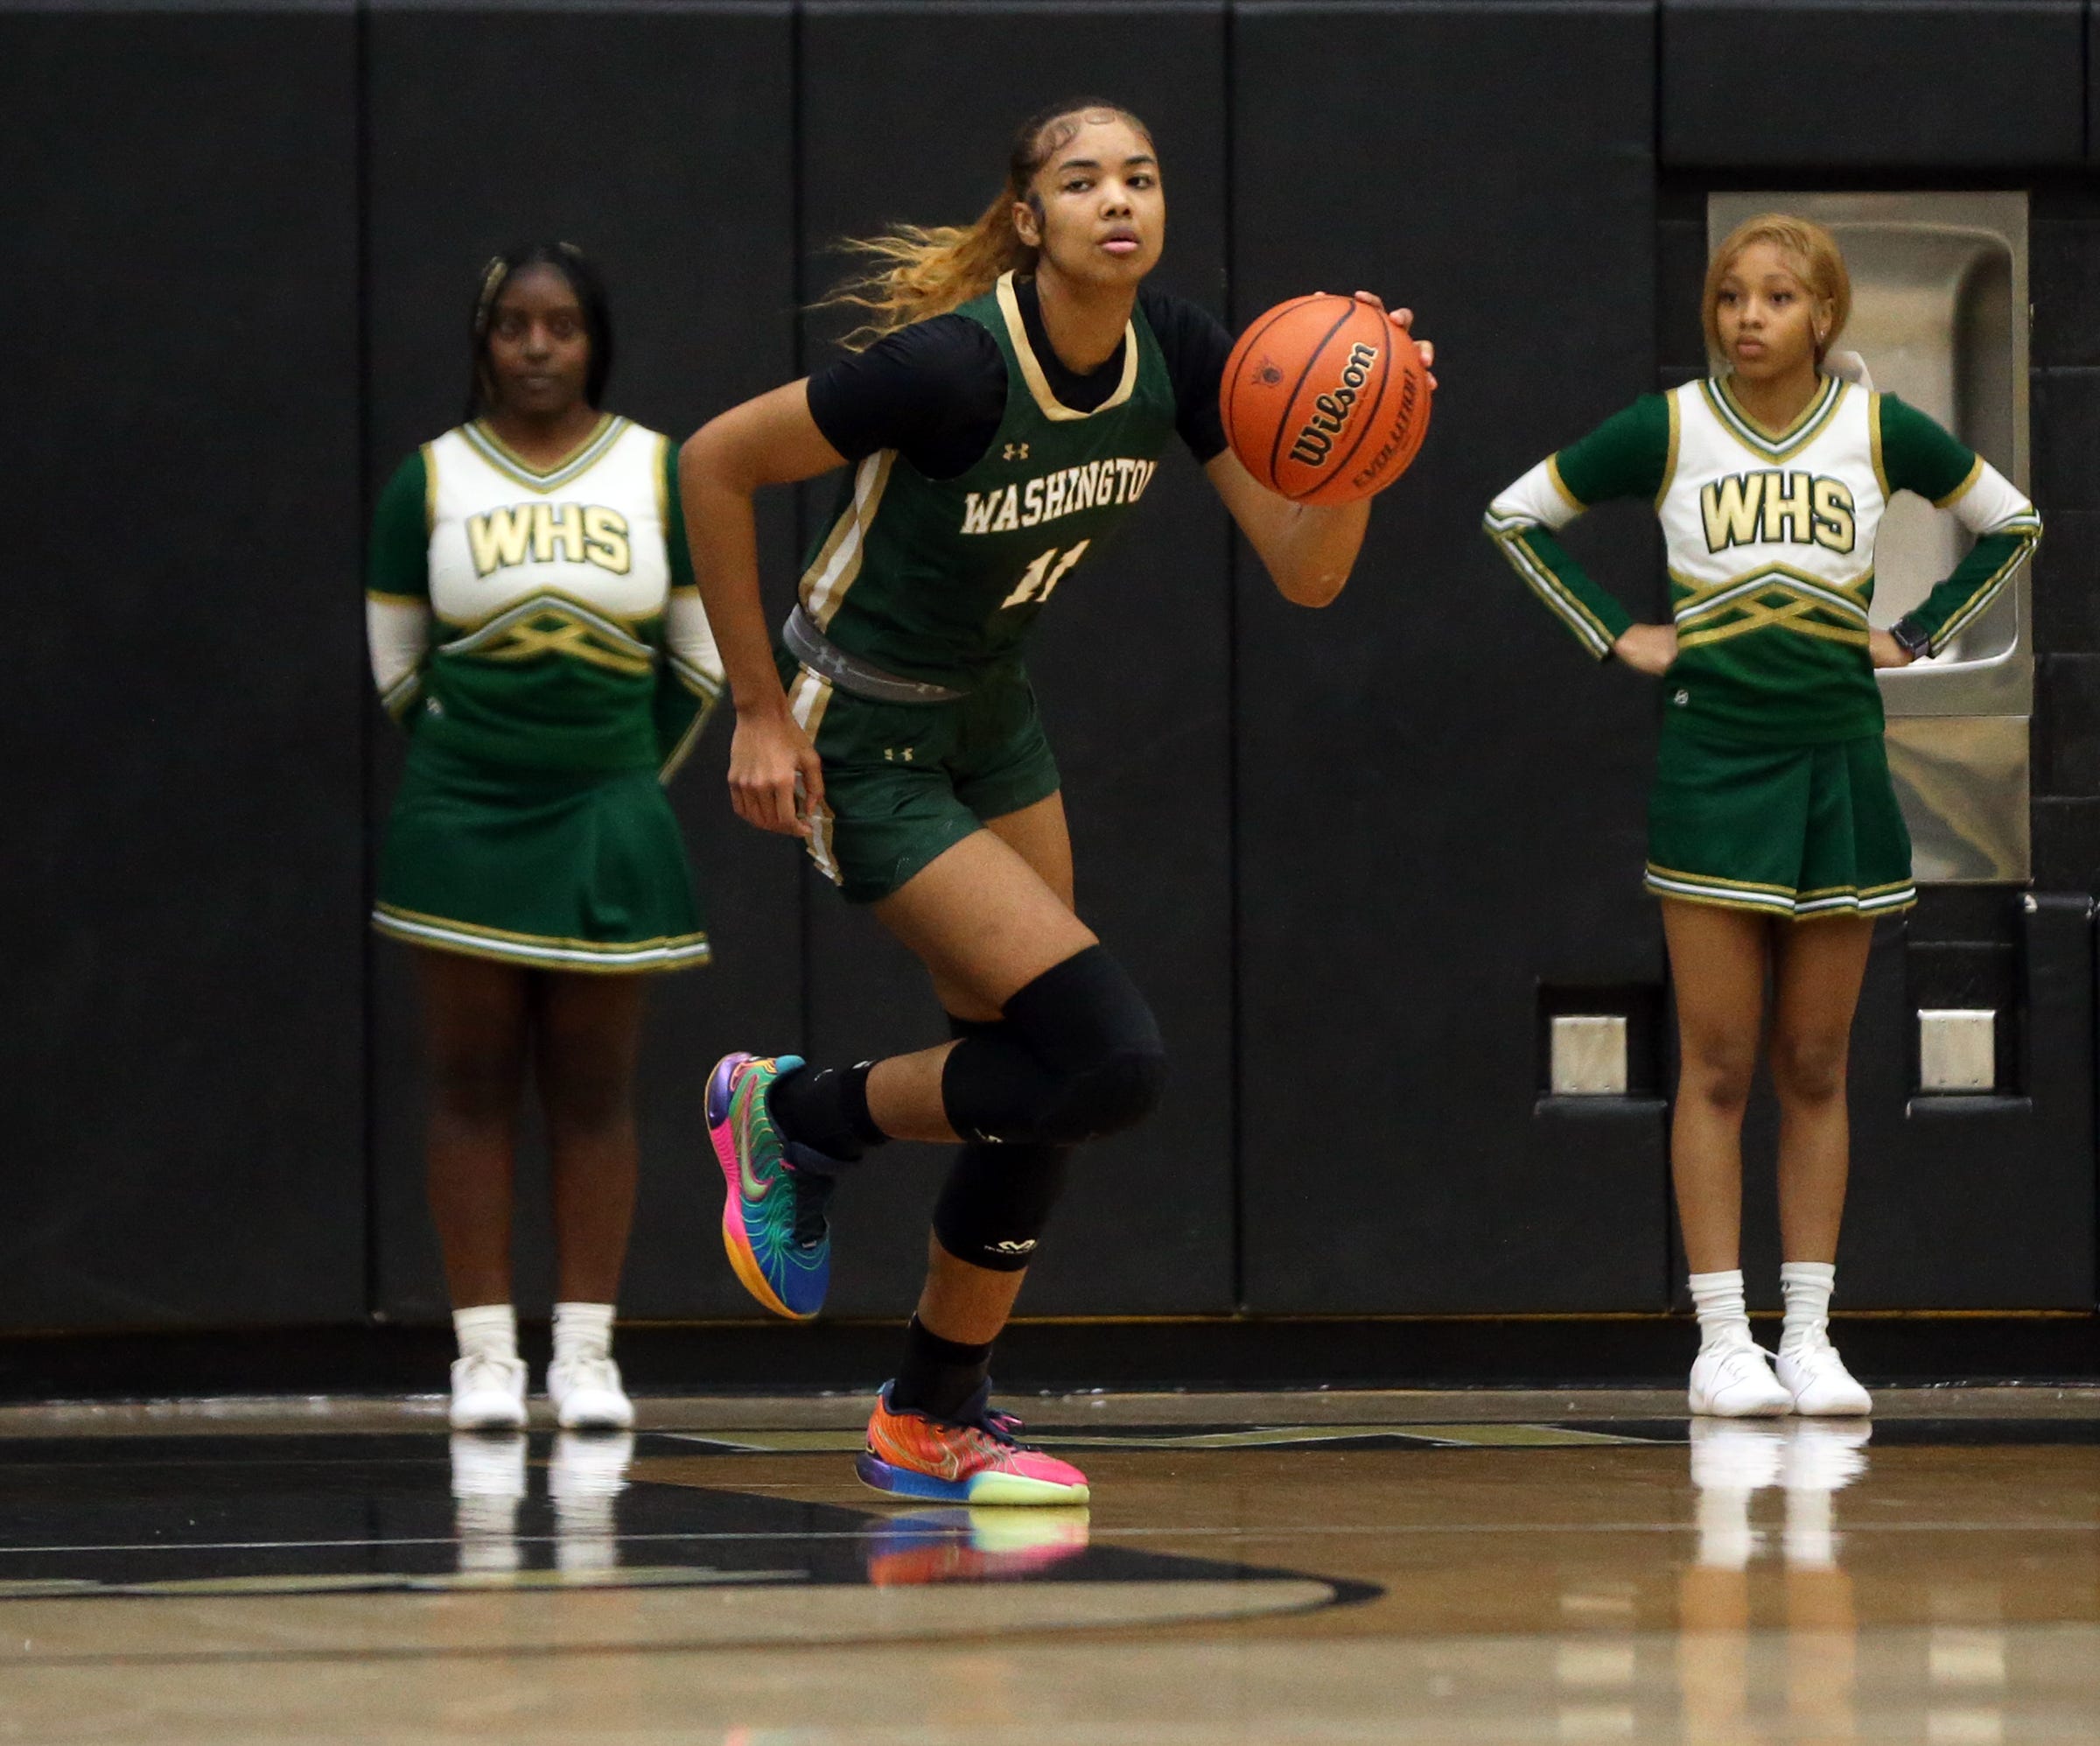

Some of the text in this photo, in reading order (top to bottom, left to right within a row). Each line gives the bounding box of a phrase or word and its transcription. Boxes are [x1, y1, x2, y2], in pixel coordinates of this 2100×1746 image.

[1288, 342, 1378, 467] Wilson
[465, 502, 631, 579] WHS
[1699, 468, 1857, 555] WHS
[999, 538, 1092, 610] 11
